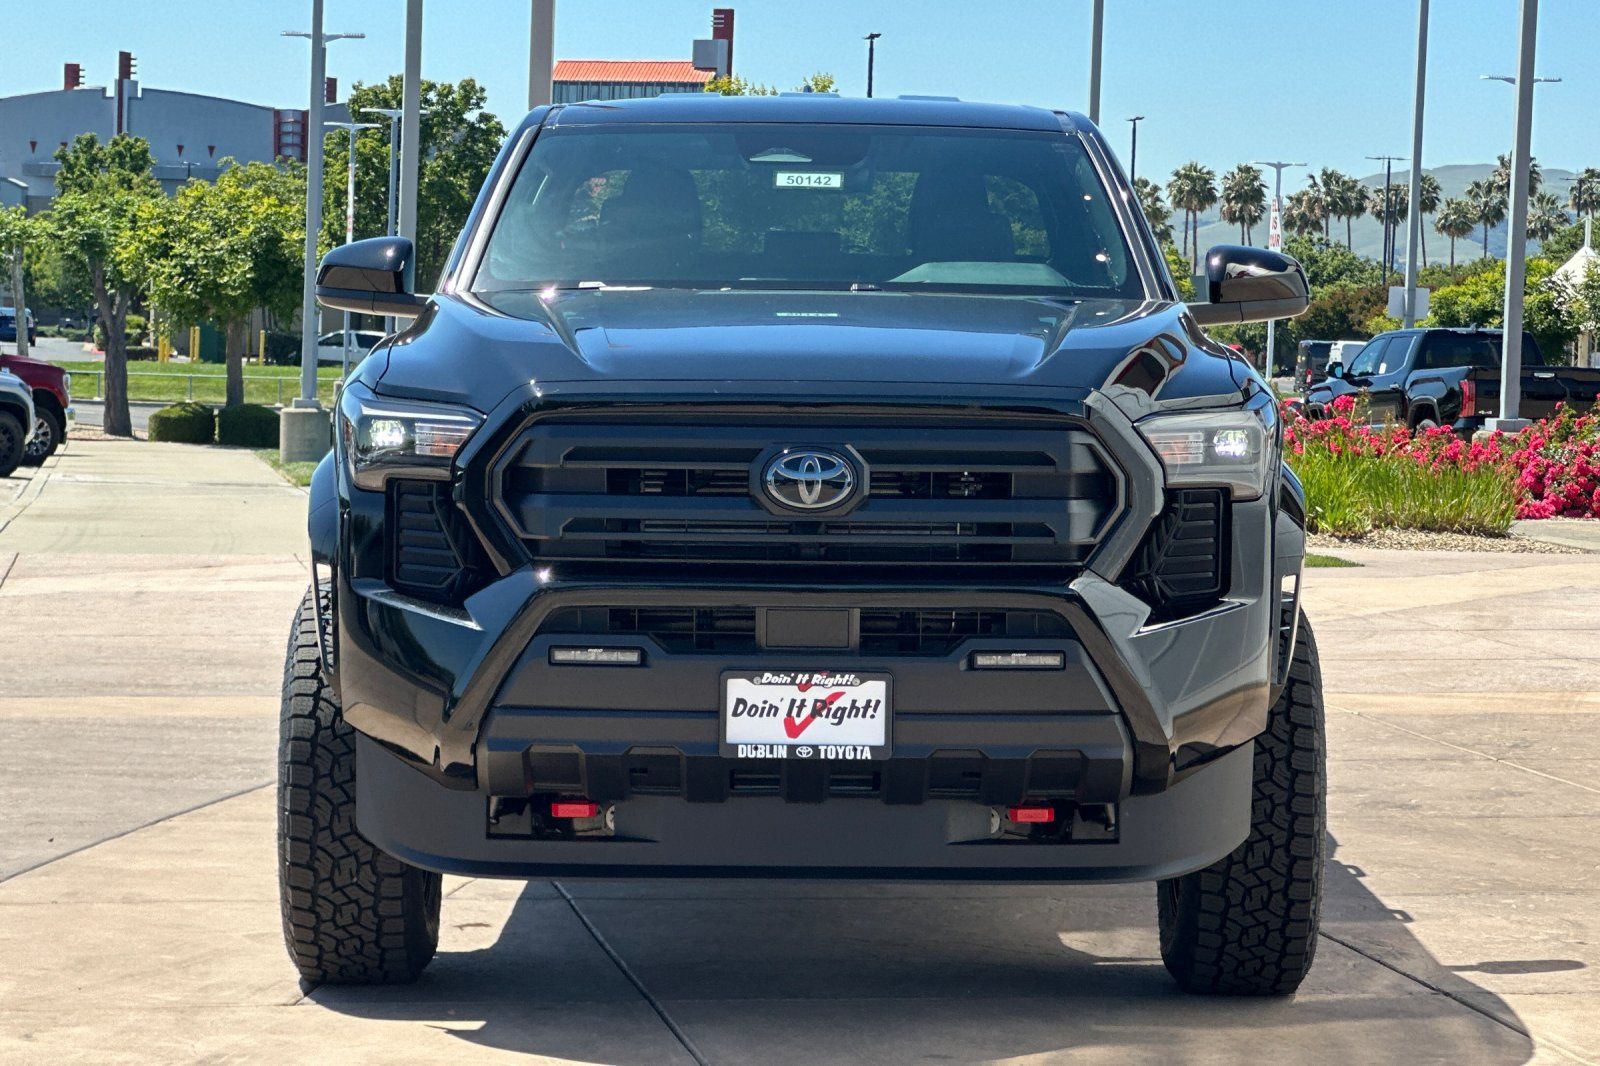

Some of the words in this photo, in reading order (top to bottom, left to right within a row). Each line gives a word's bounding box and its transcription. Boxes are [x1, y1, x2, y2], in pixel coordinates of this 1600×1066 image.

[786, 175, 832, 186] 50142
[761, 672, 795, 684] Doin'
[795, 673, 810, 685] It
[811, 673, 856, 689] Right!
[731, 697, 784, 718] Doin'
[786, 698, 808, 718] It
[810, 698, 882, 727] Right!
[737, 744, 788, 759] DUBLIN
[818, 745, 872, 760] TOYOTA
